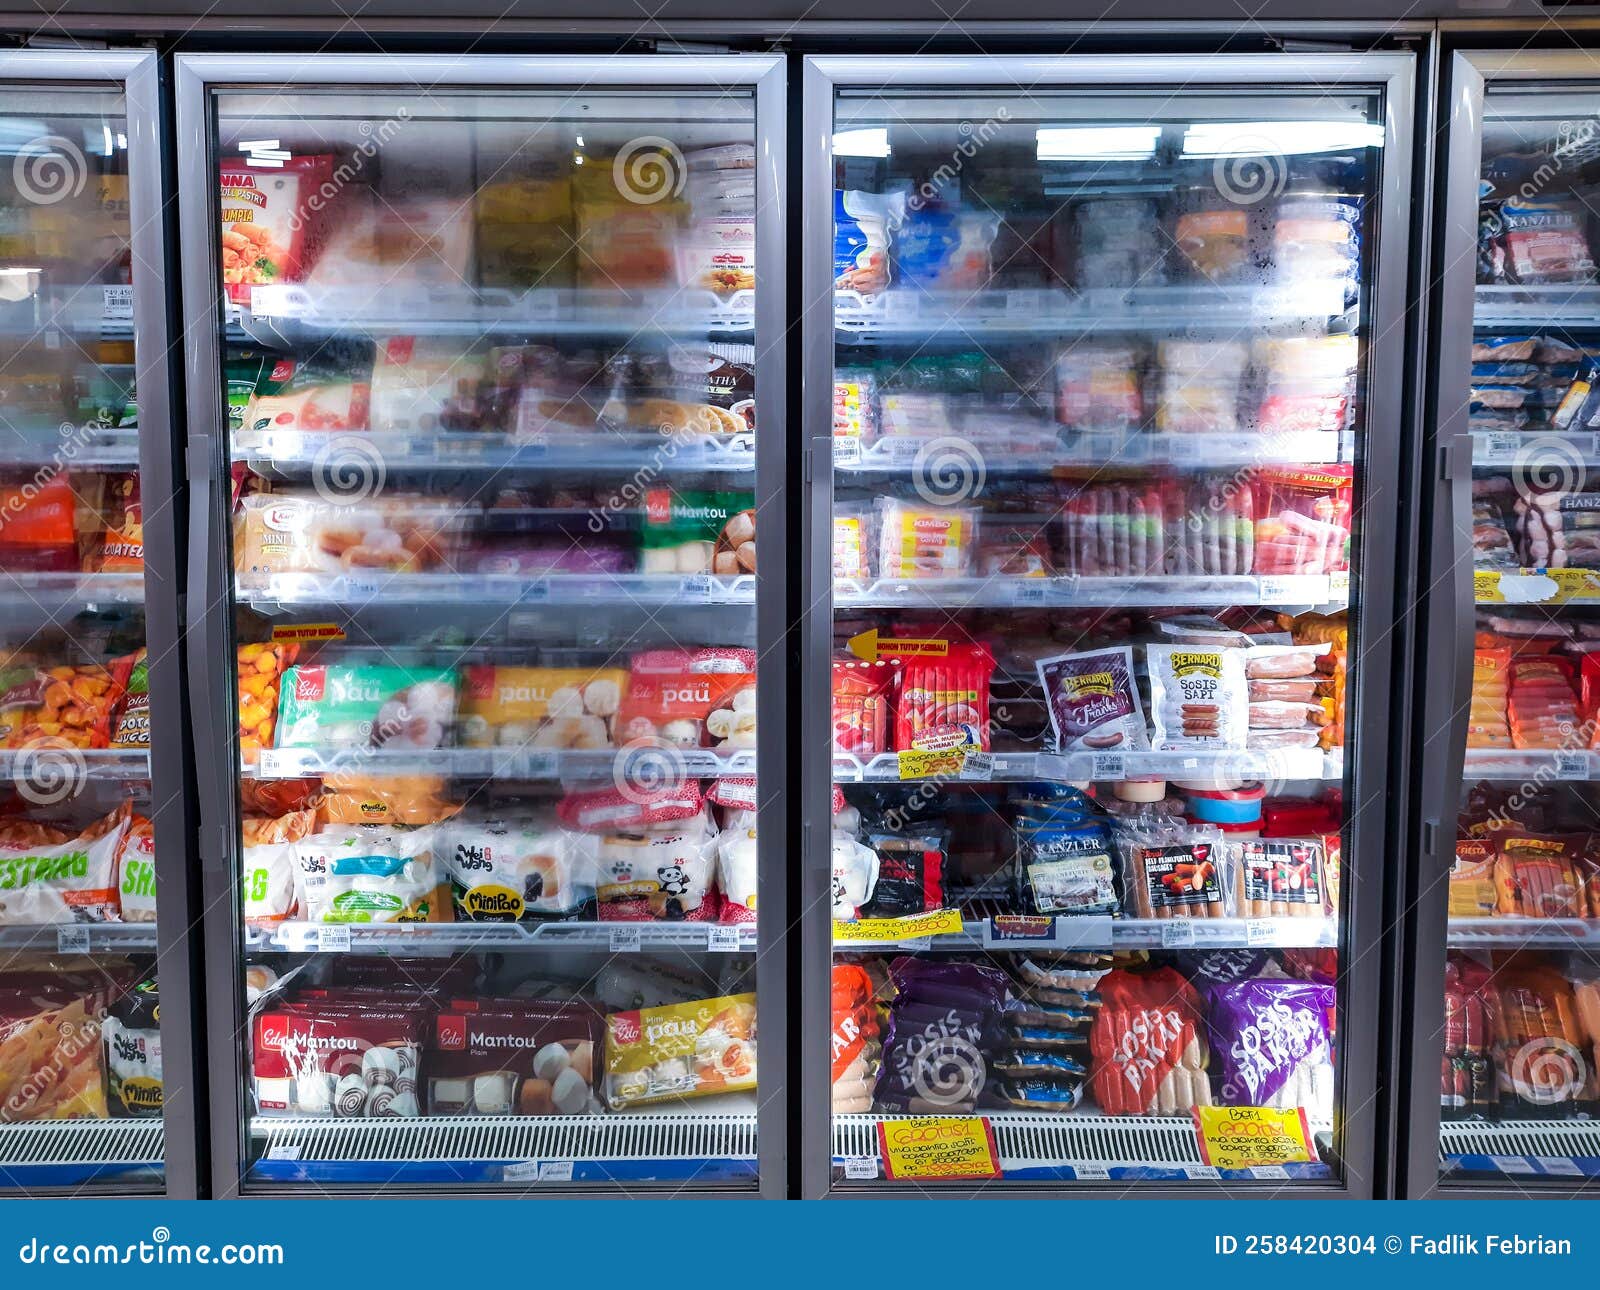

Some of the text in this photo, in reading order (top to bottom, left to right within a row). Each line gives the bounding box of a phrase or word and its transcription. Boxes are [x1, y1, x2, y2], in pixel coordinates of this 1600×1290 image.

[674, 505, 727, 519] Mantou
[1170, 652, 1223, 669] BERNARDI
[661, 686, 710, 713] pau
[1184, 690, 1214, 700] SAPI
[457, 844, 484, 860] Wei
[1035, 838, 1102, 855] KANZLER
[1460, 847, 1486, 855] FIESTA
[455, 854, 493, 872] Wang
[469, 892, 520, 912] MiniPao
[293, 1032, 358, 1051] Mantou
[440, 1027, 536, 1049] Edo Mantou
[1123, 1010, 1185, 1094] BAKAR
